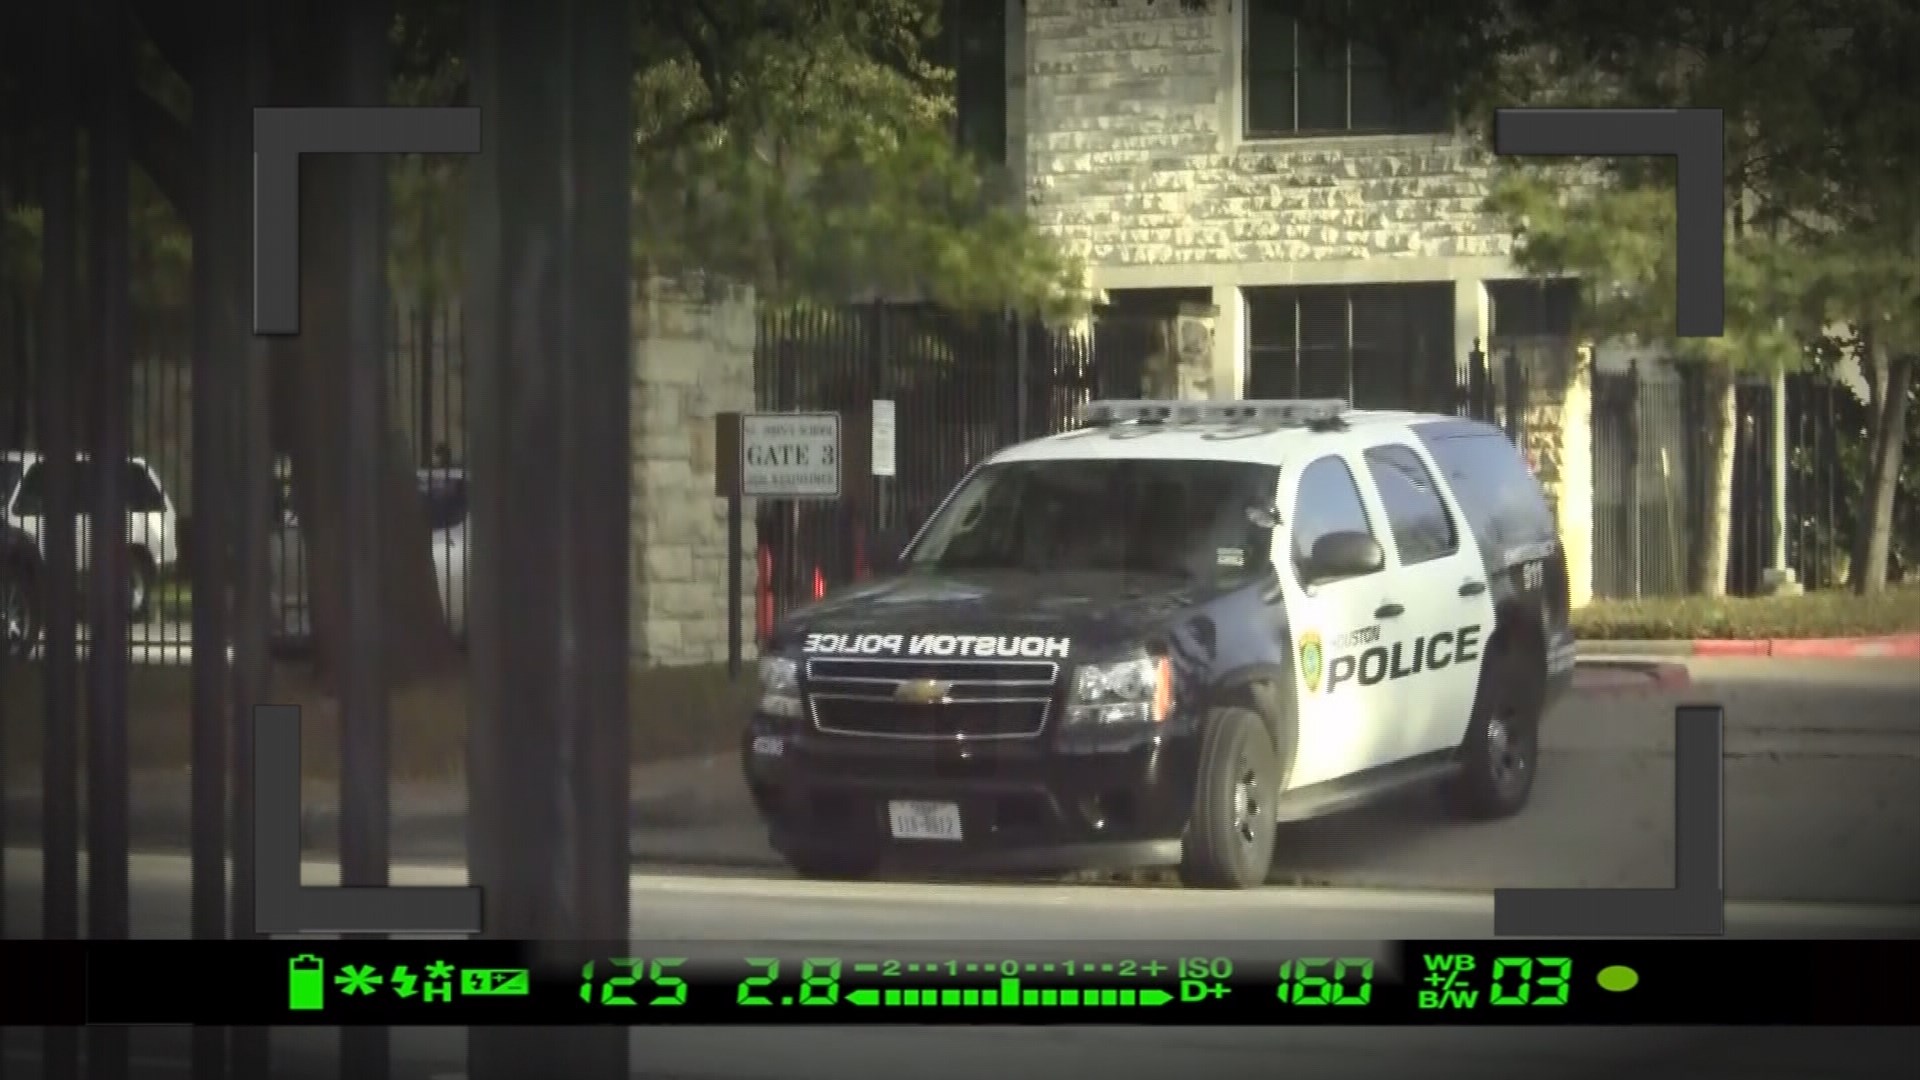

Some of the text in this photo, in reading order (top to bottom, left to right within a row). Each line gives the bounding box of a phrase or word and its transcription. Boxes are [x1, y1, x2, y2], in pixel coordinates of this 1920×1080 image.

[747, 444, 835, 466] GATE 3
[1326, 624, 1481, 694] POLICE
